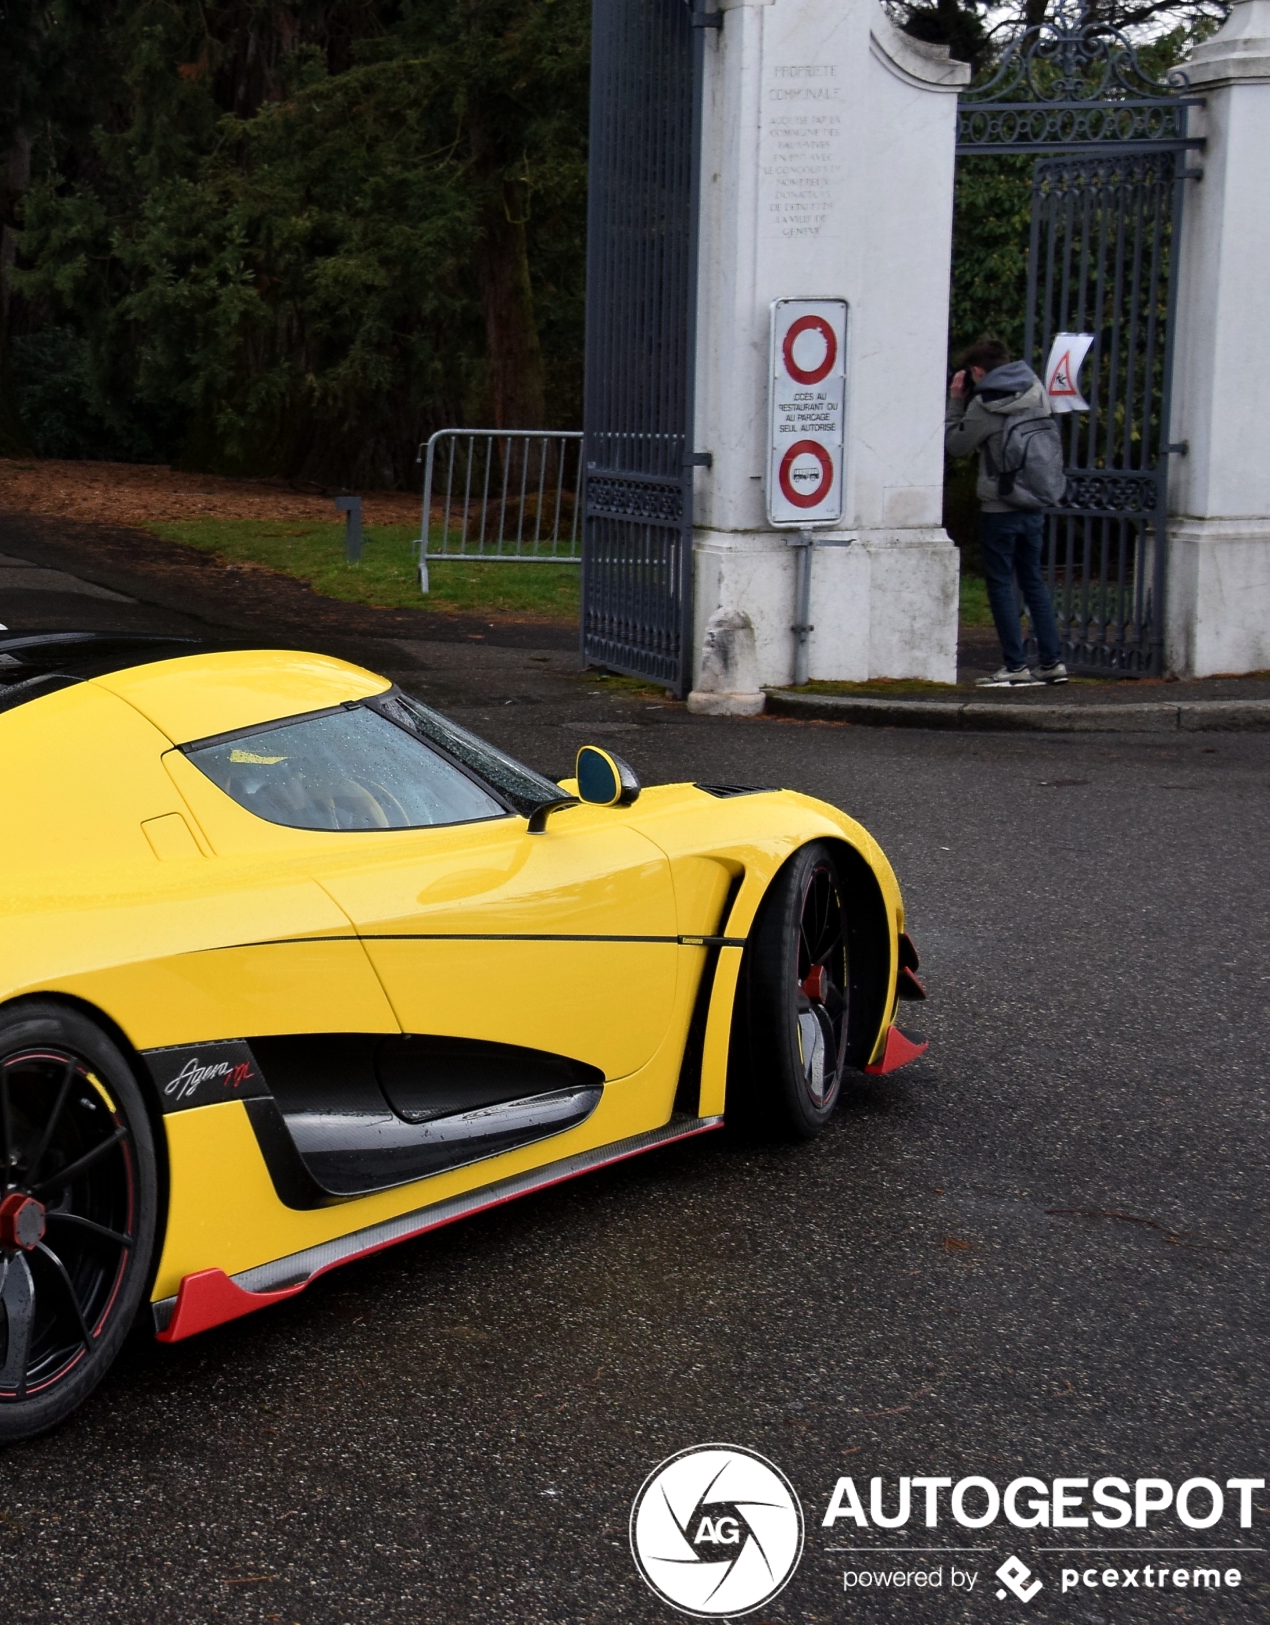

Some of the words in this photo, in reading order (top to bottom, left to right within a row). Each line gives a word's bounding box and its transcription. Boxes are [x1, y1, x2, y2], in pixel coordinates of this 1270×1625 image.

[817, 392, 827, 401] AU
[827, 402, 838, 411] OU
[786, 414, 796, 422] AU
[797, 413, 831, 421] PARCAGE
[779, 424, 797, 433] SEUL
[164, 1057, 234, 1101] Agera
